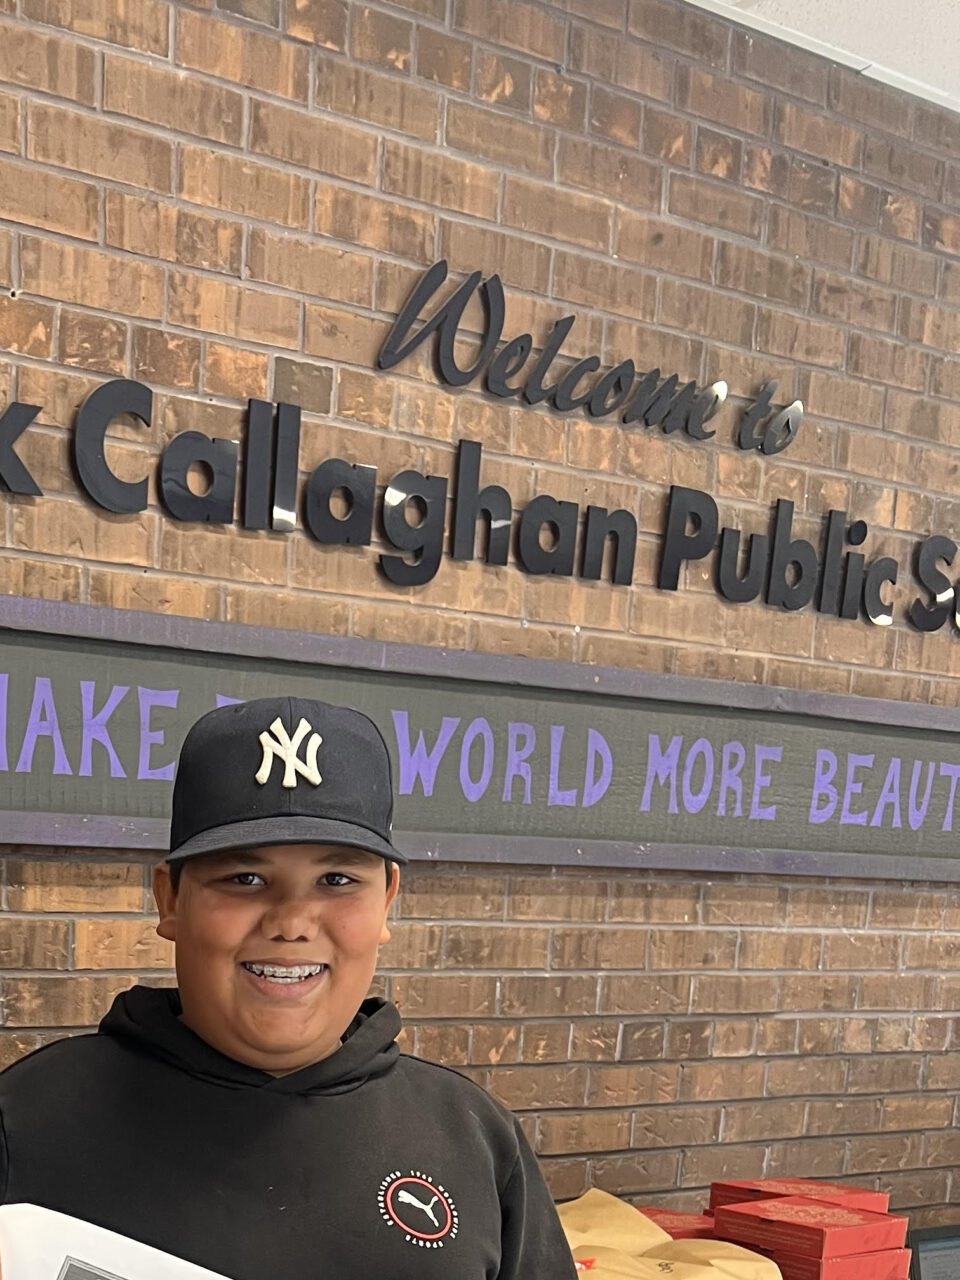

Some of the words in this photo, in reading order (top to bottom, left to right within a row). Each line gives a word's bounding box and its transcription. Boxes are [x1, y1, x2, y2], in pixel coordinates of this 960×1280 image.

[378, 258, 729, 441] Welcome
[738, 378, 805, 457] to
[73, 377, 638, 588] Callaghan
[657, 484, 901, 627] Public
[908, 533, 960, 634] S
[255, 716, 324, 789] NY
[390, 709, 615, 809] WORLD
[639, 732, 785, 822] MORE
